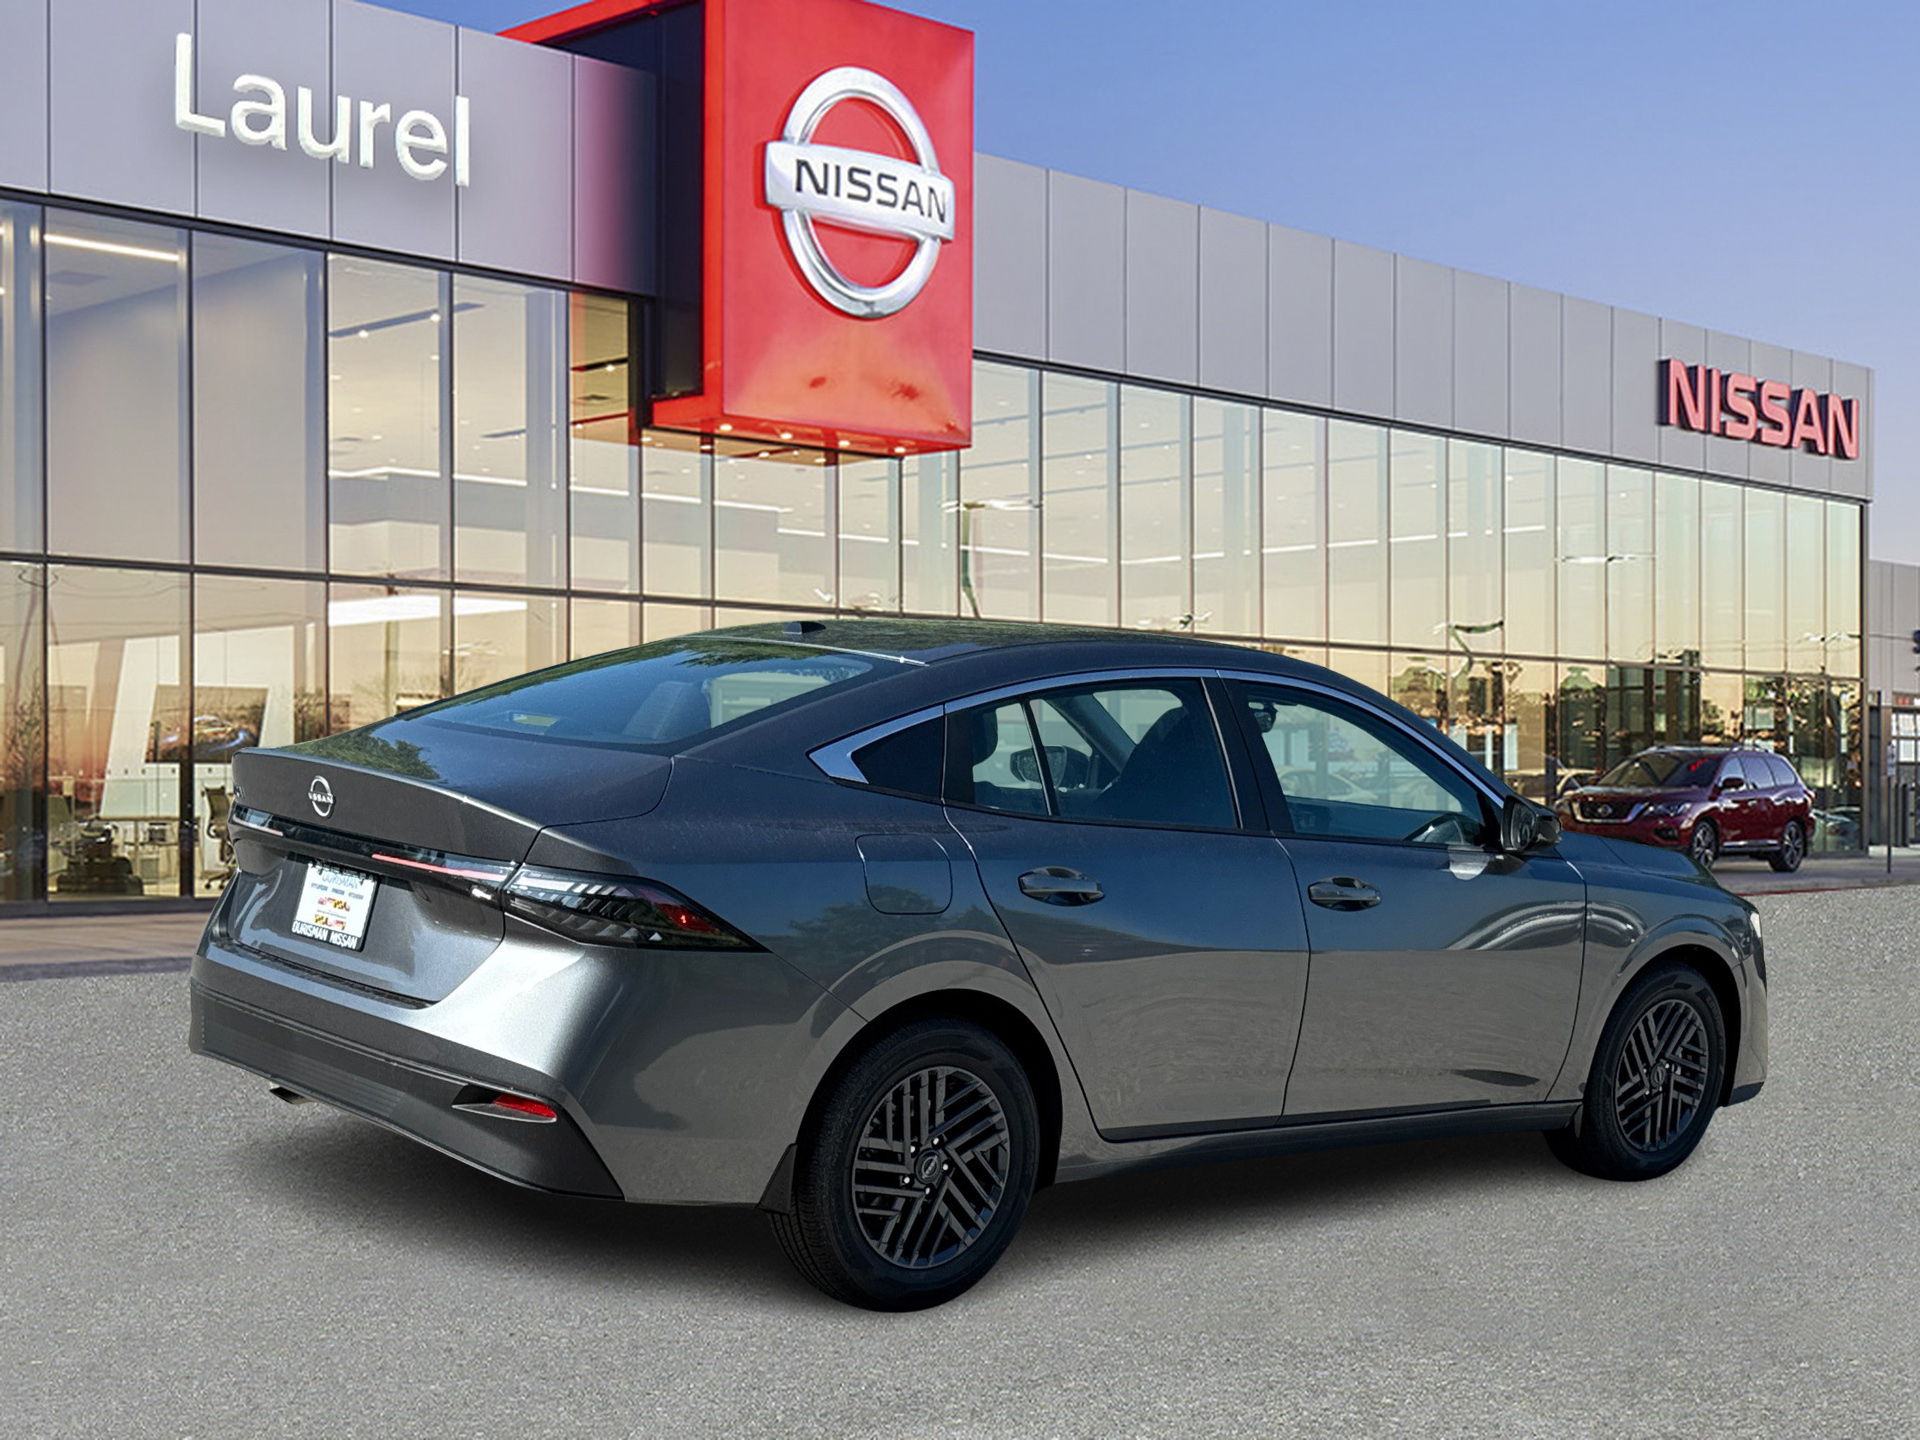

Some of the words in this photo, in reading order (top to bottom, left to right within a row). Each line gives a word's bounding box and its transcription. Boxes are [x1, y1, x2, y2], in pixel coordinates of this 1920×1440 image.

[175, 32, 470, 188] Laurel
[794, 157, 946, 224] NISSAN
[1660, 358, 1860, 460] NISSAN
[291, 920, 329, 941] OURISMAN
[329, 930, 359, 950] NISSAN
